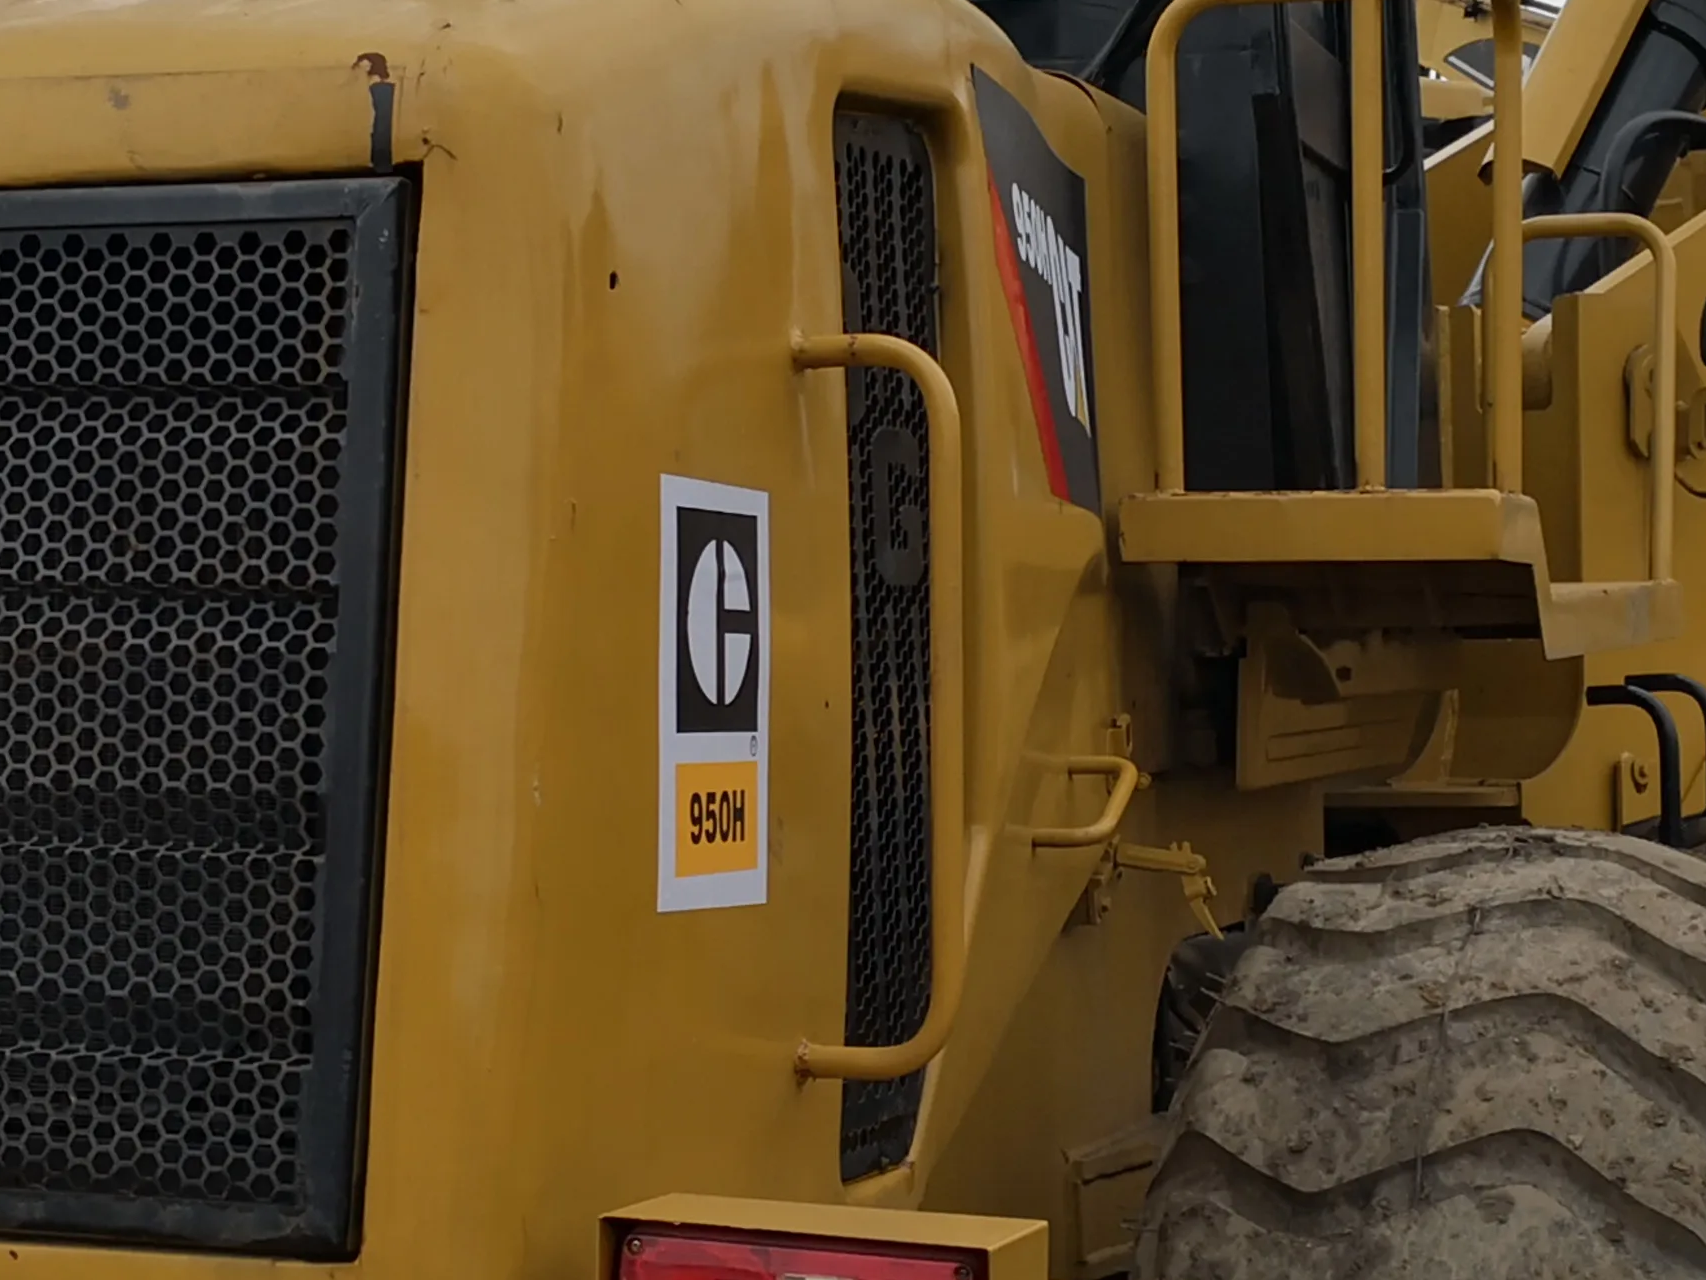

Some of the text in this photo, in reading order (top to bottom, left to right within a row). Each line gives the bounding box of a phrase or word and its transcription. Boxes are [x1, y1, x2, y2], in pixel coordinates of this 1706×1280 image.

[1011, 182, 1053, 286] 950H
[1045, 215, 1092, 439] CAT
[689, 790, 746, 845] 950H
